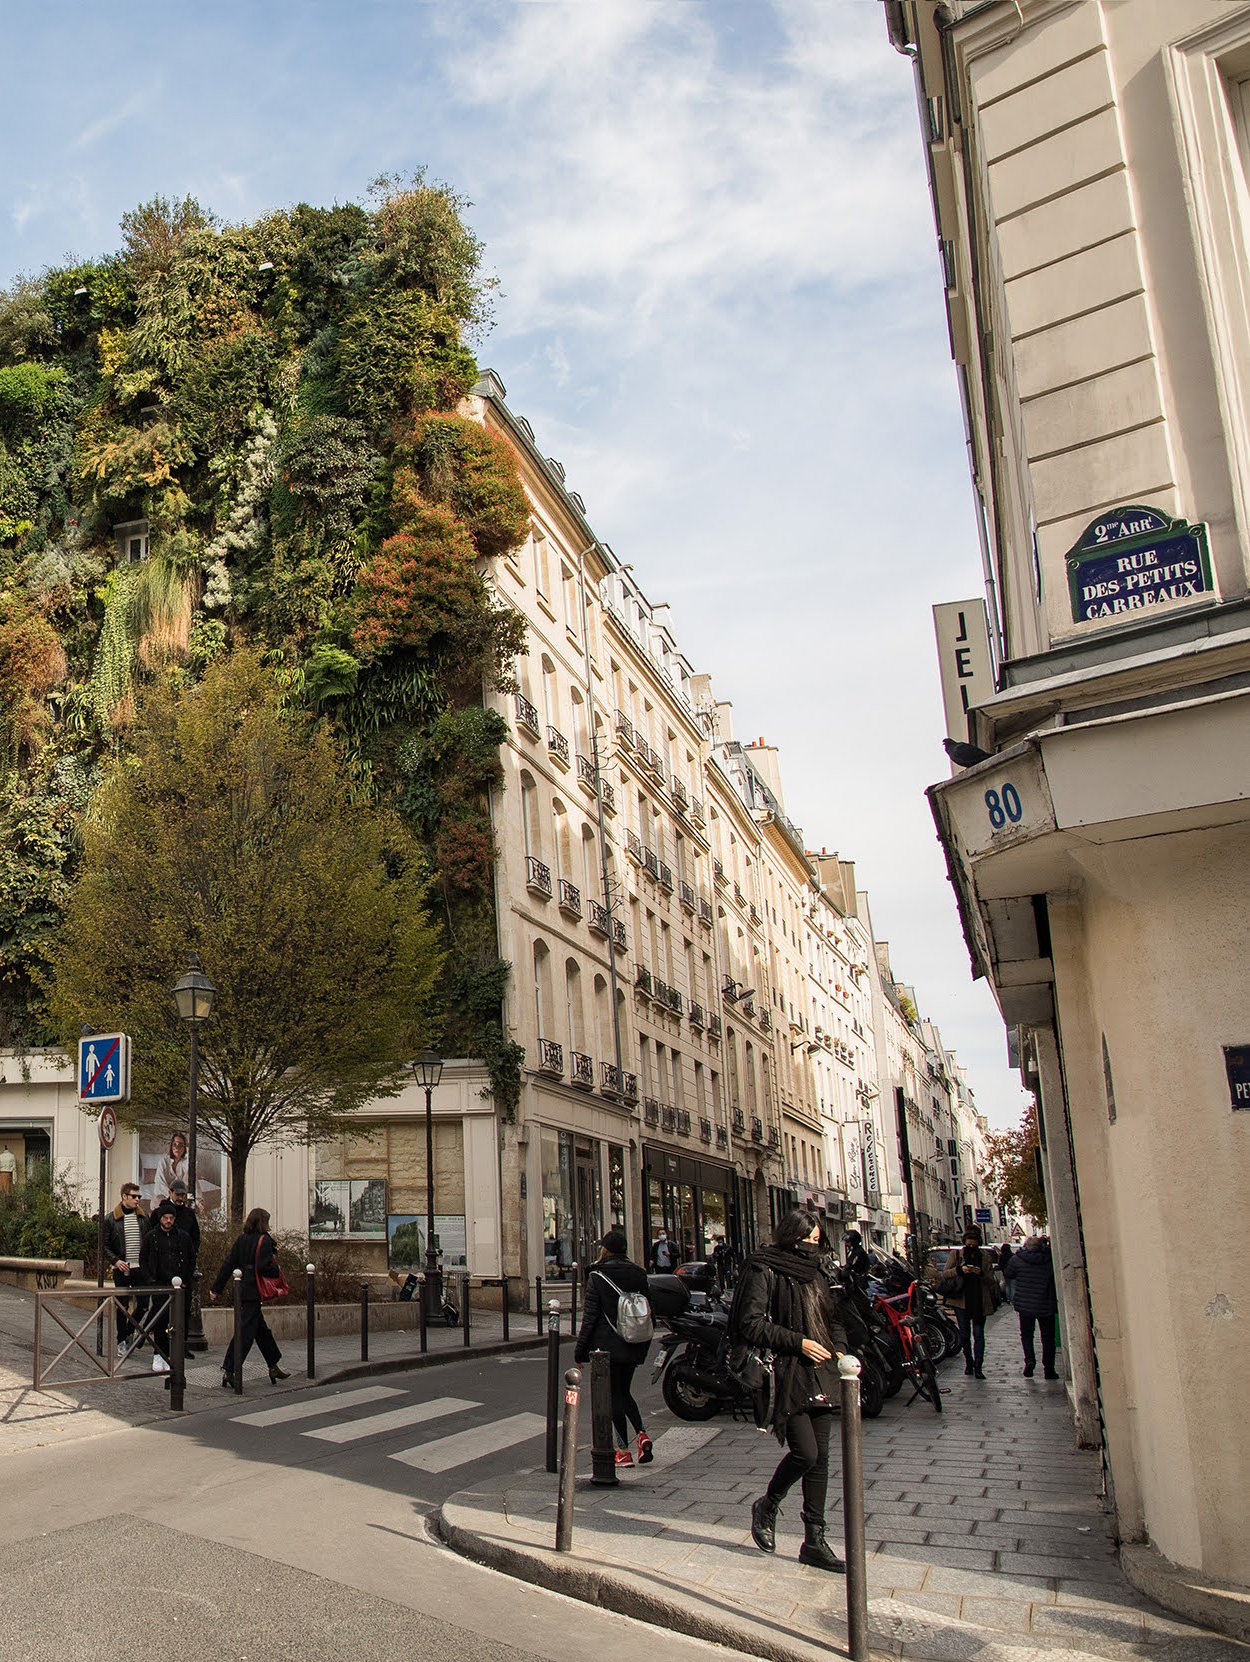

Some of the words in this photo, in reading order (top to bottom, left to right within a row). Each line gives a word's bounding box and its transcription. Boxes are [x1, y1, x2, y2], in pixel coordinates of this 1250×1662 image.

[1082, 580, 1120, 601] DES
[1125, 560, 1198, 590] PETITS
[1116, 550, 1158, 573] RUE
[1086, 580, 1197, 619] CARREAUX
[984, 782, 1023, 830] 80
[1235, 1082, 1250, 1100] PE
